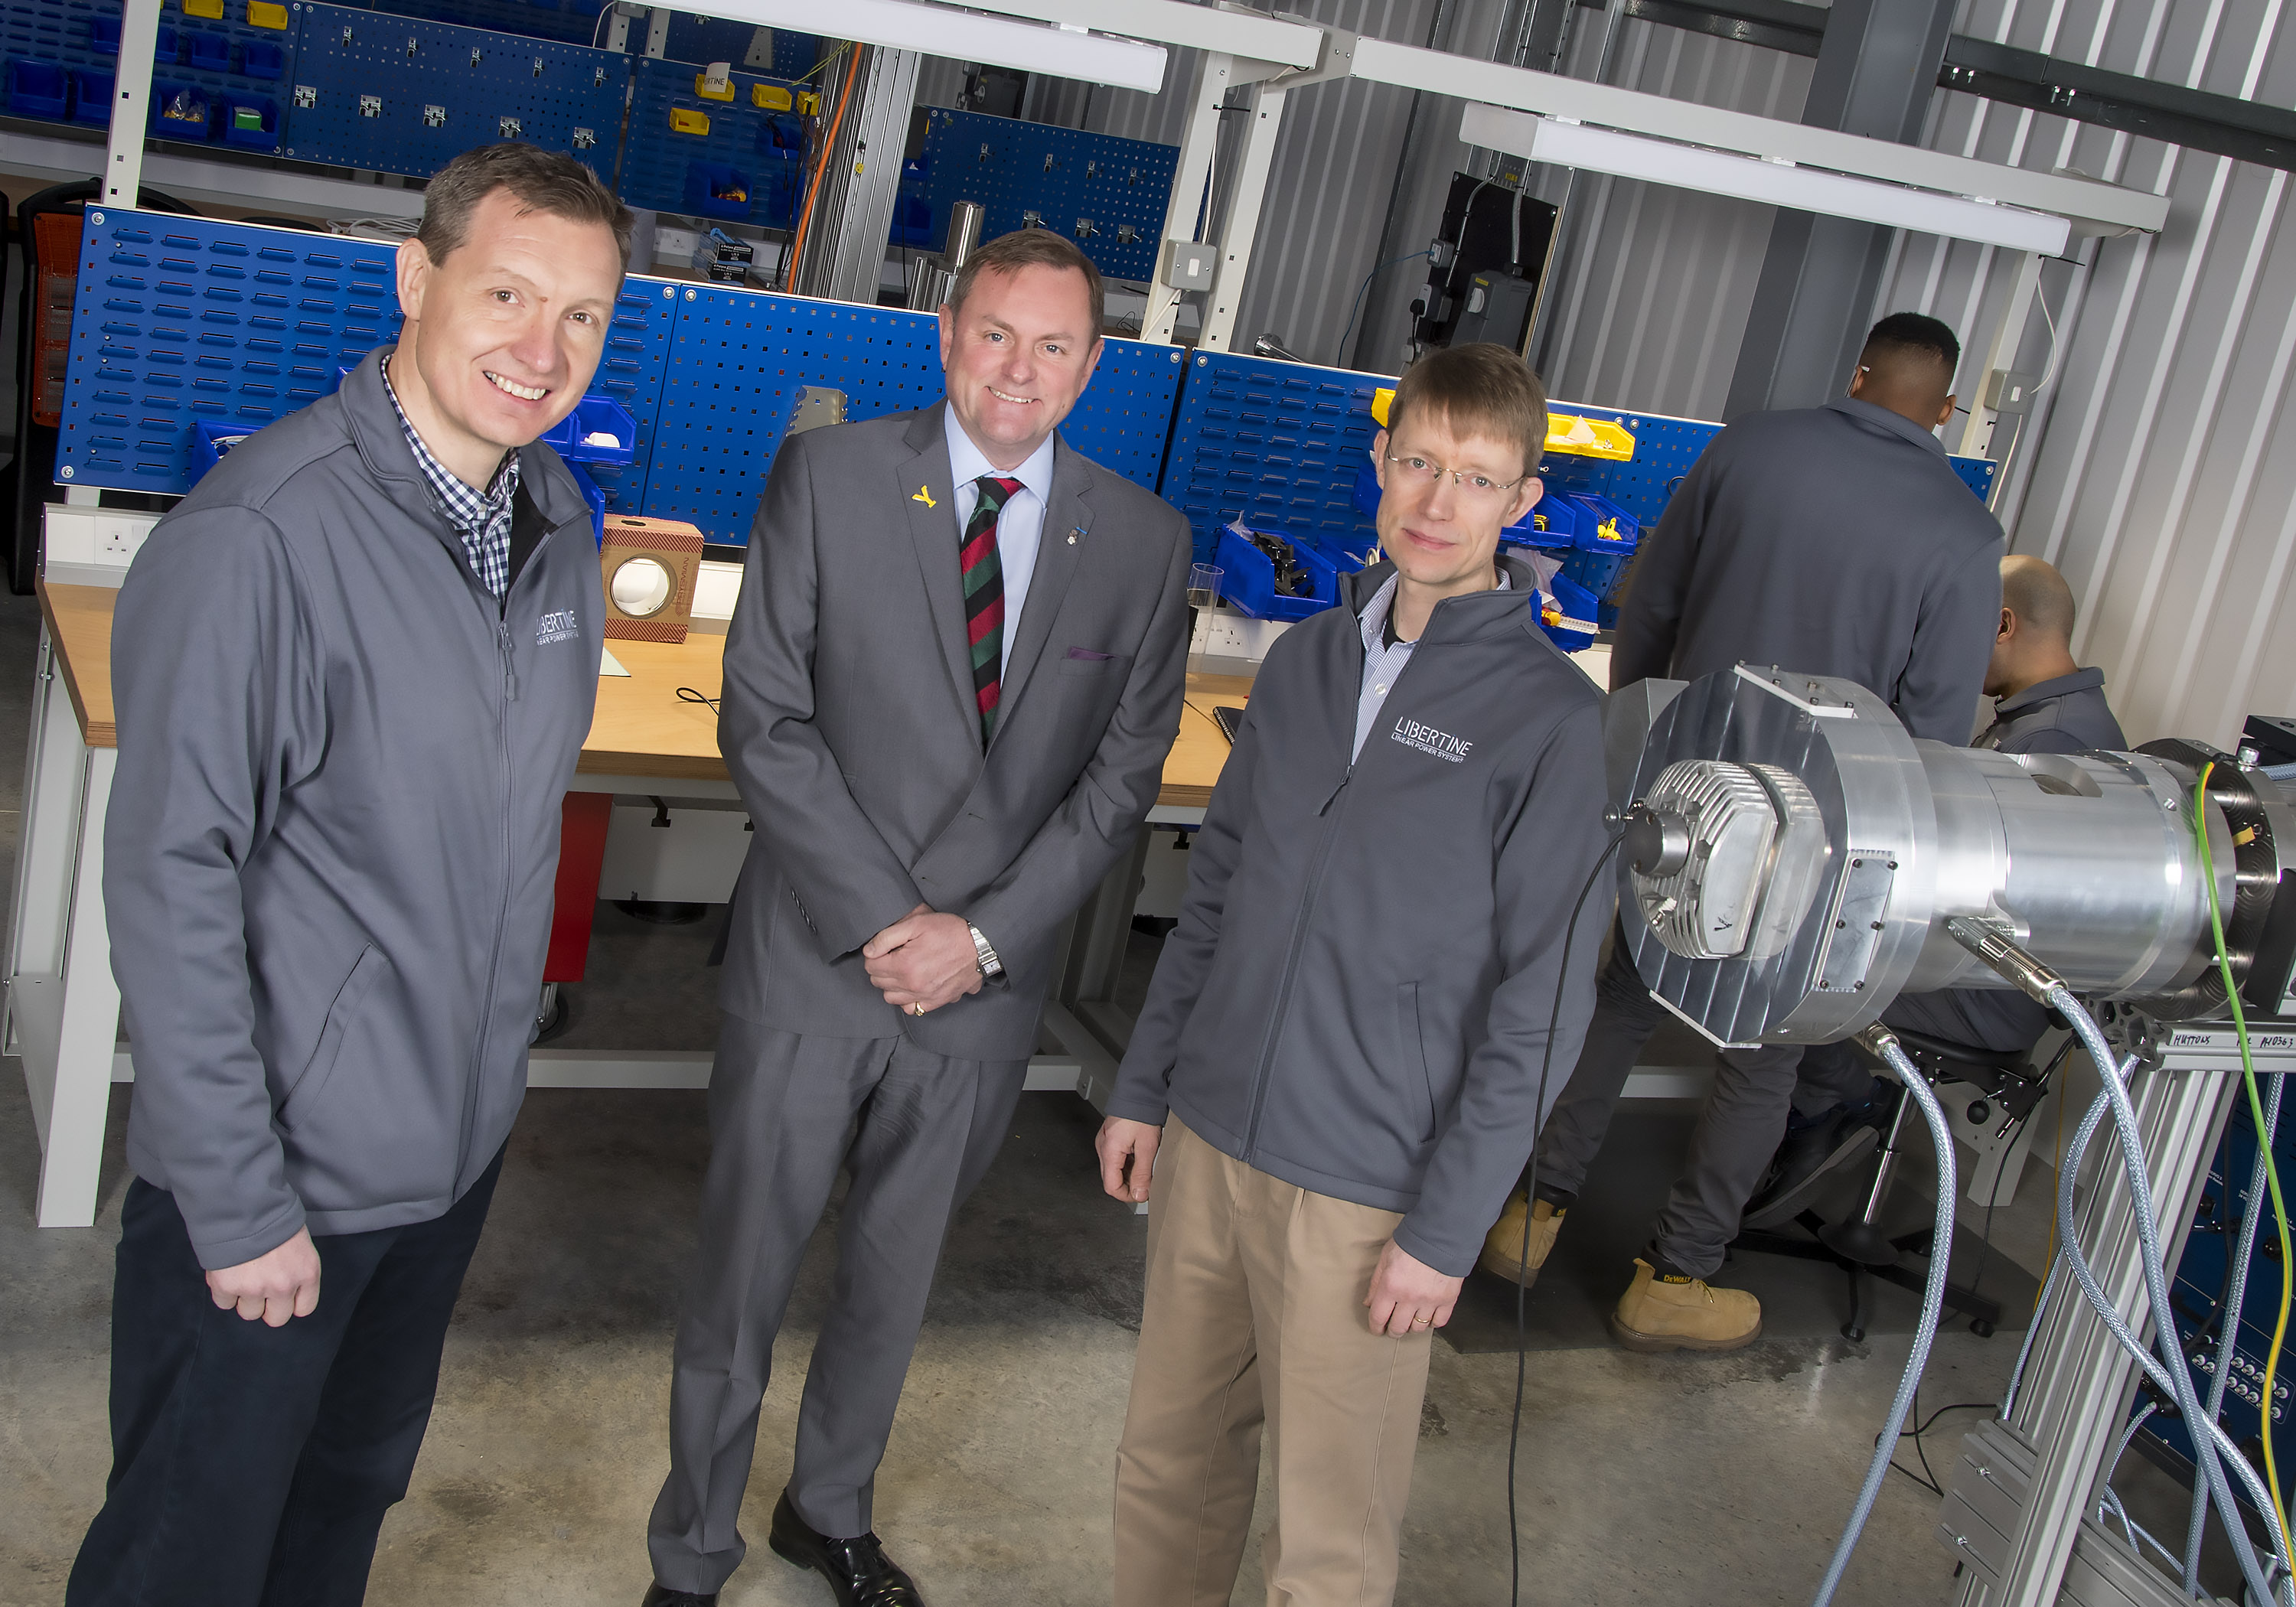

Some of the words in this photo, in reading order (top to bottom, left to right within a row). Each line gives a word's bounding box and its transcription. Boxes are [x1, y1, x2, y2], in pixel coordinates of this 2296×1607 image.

[677, 557, 690, 605] PRYSMIAN
[1391, 732, 1415, 748] LINEAR
[1414, 743, 1437, 757] POWER
[1437, 751, 1465, 764] SYSTEMS
[1394, 715, 1473, 756] LIBERTINE
